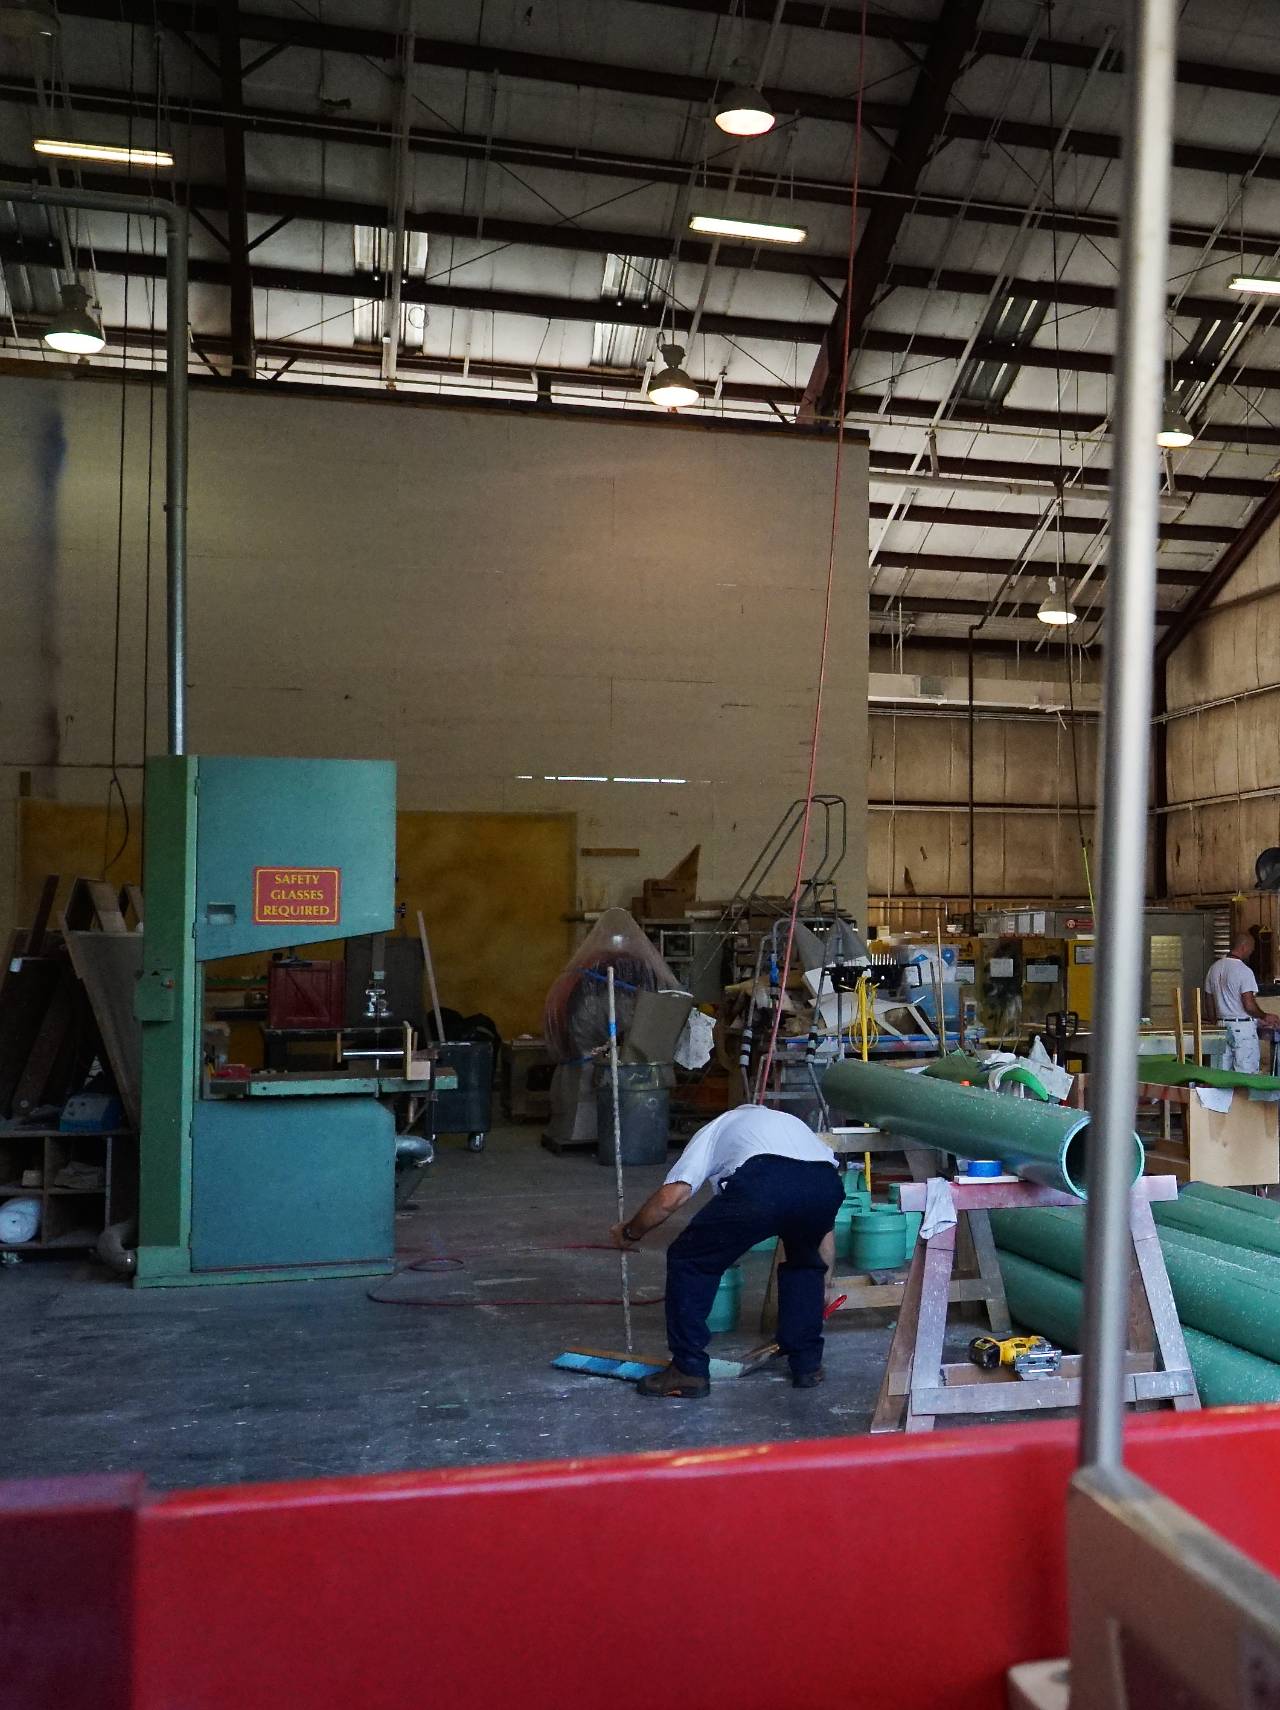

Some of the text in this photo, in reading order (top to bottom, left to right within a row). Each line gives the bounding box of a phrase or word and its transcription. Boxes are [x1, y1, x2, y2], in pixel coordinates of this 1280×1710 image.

[274, 874, 320, 885] SAFETY
[270, 889, 324, 900] GLASSES
[263, 905, 330, 917] REQUIRED
